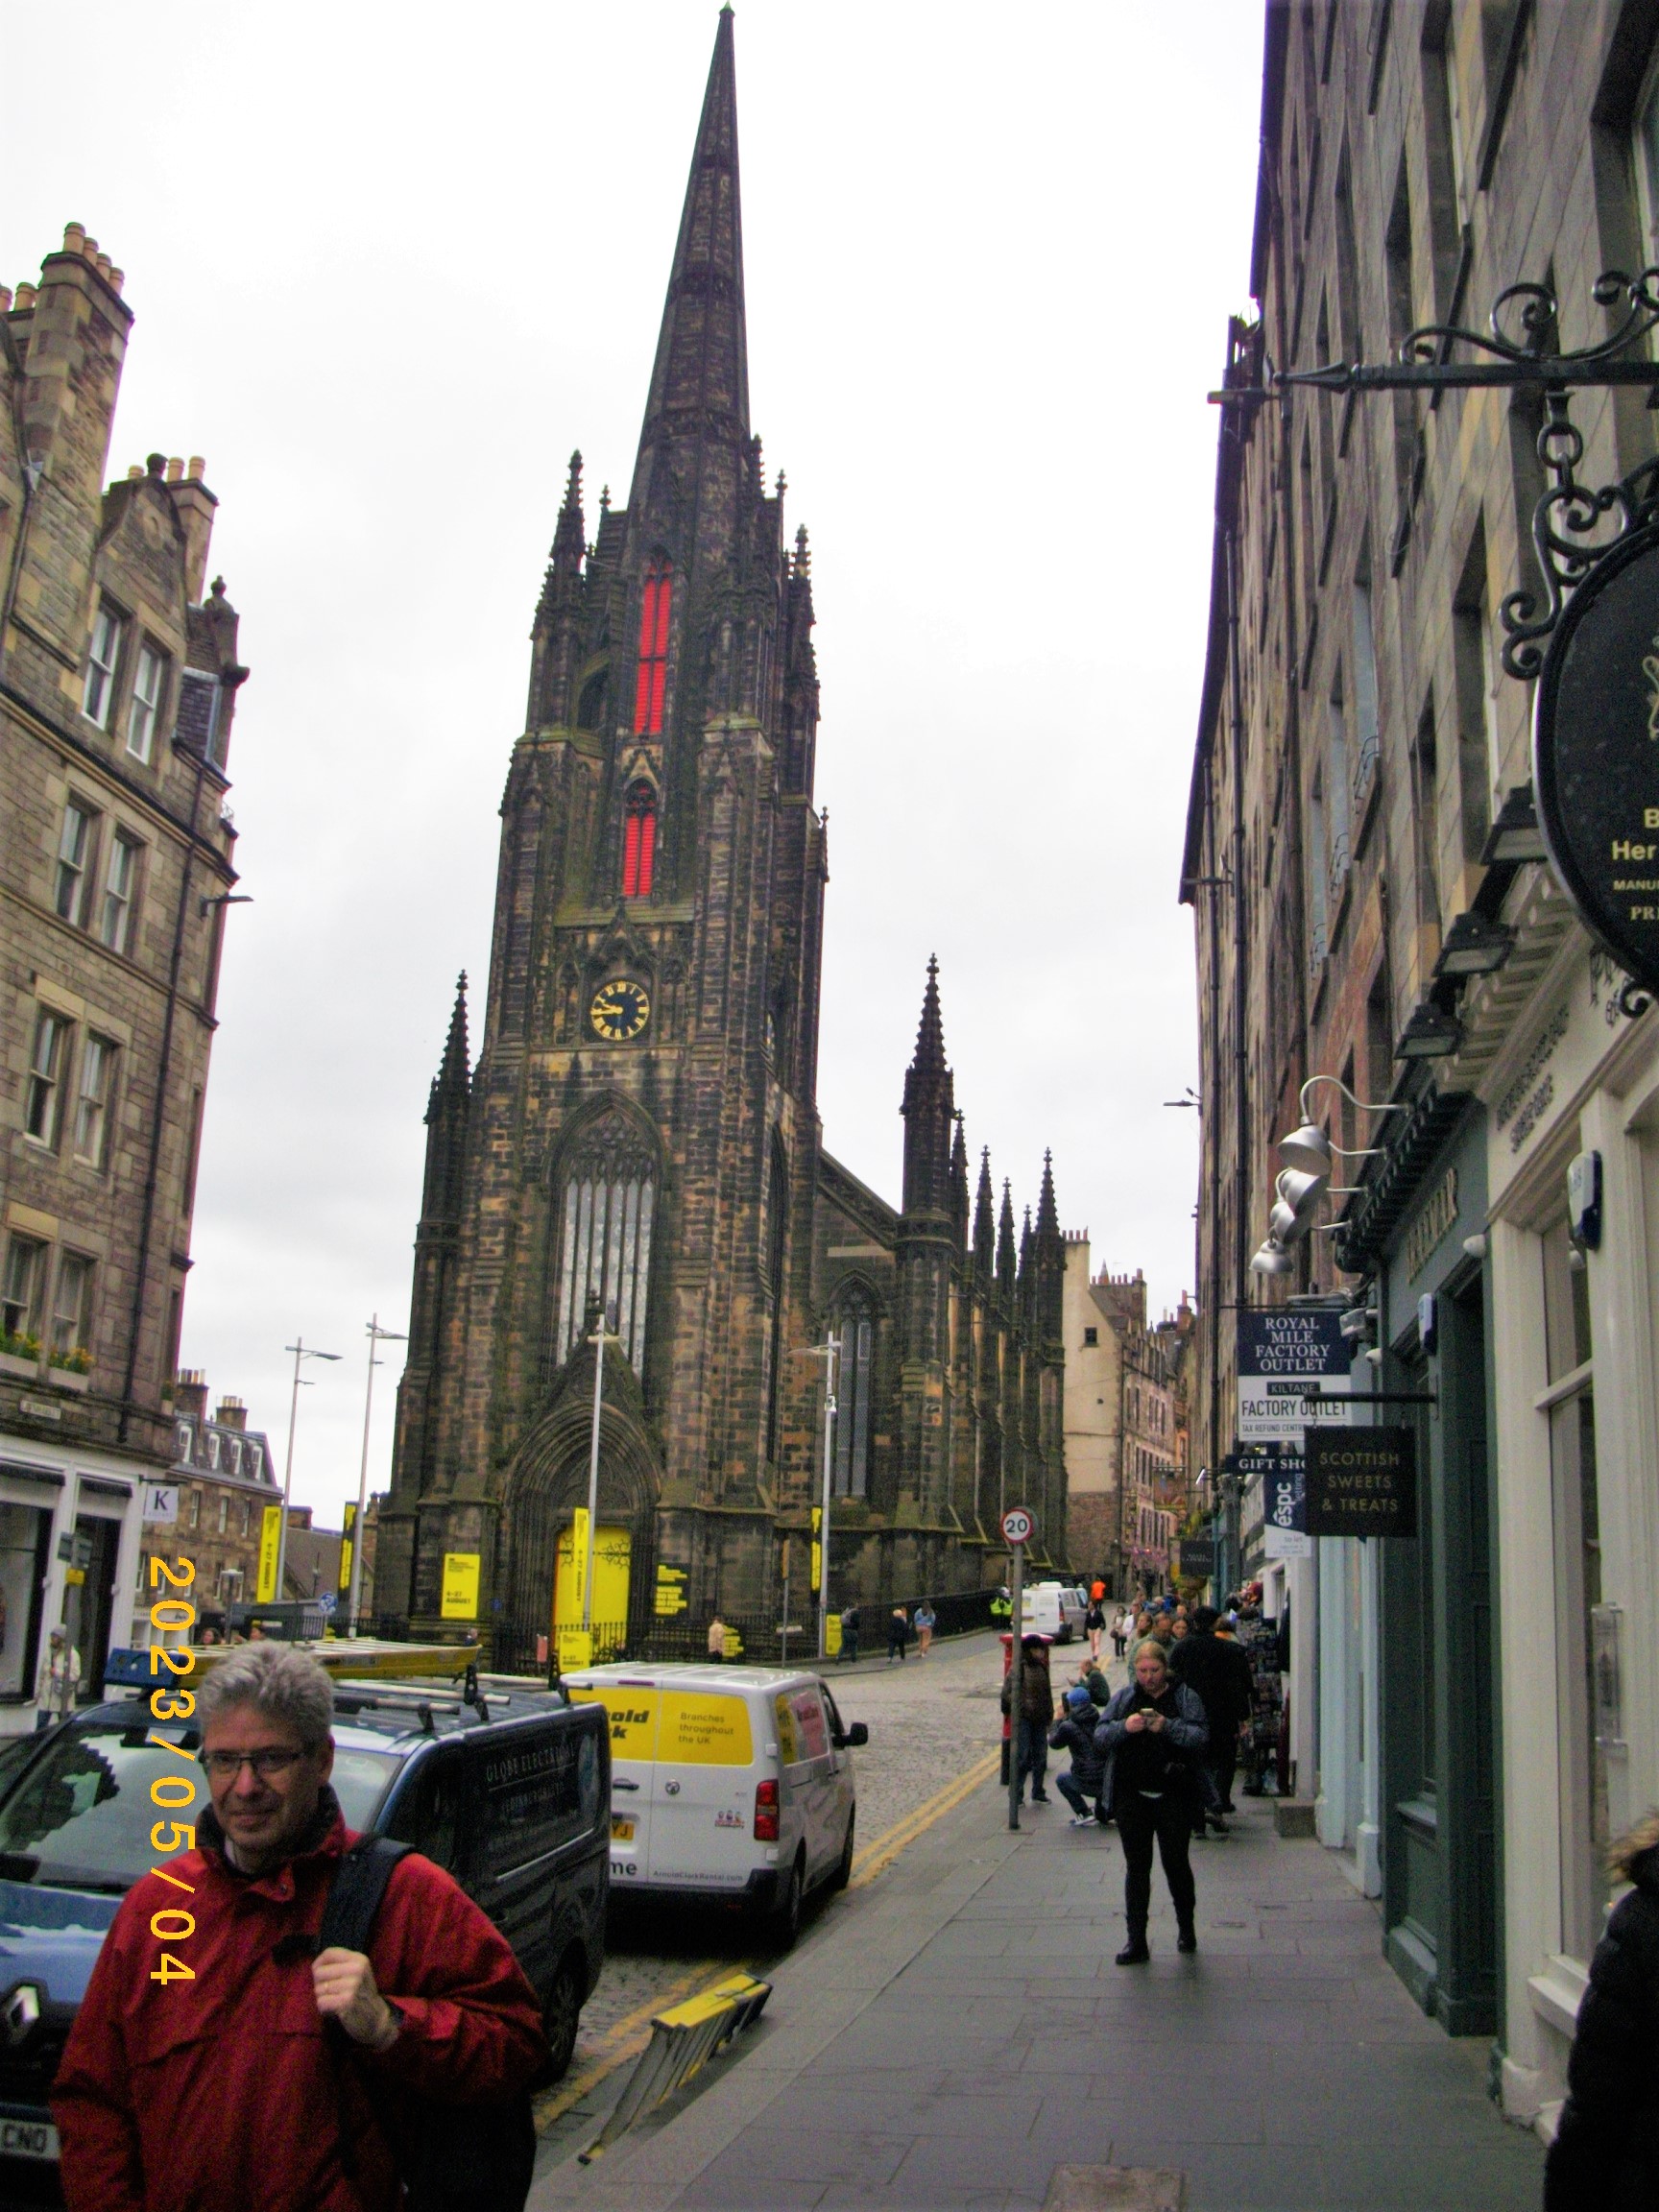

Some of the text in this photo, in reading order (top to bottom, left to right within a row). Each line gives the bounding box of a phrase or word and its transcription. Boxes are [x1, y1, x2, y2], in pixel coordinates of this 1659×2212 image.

[1614, 879, 1659, 891] MANU
[1630, 905, 1659, 921] PR
[1264, 1317, 1319, 1331] ROYAL
[1271, 1332, 1313, 1343] MILE
[1255, 1344, 1331, 1358] FACTORY
[1260, 1358, 1326, 1371] OUTLET
[1270, 1382, 1316, 1393] KILTANE
[1242, 1400, 1296, 1416] FACTORY
[1242, 1424, 1305, 1432] TAX REFUND CENTR
[1238, 1457, 1276, 1469] GIFT
[1319, 1453, 1400, 1466] SCOTTISH
[1327, 1475, 1392, 1489] SWEETS
[155, 1490, 170, 1510] K
[1273, 1482, 1296, 1527] espc
[1321, 1498, 1399, 1511] & TREATS
[1006, 1519, 1027, 1533] 20
[608, 1709, 650, 1723] old
[681, 1712, 725, 1722] Branches
[680, 1723, 734, 1735] throughout
[678, 1735, 710, 1744] the UK
